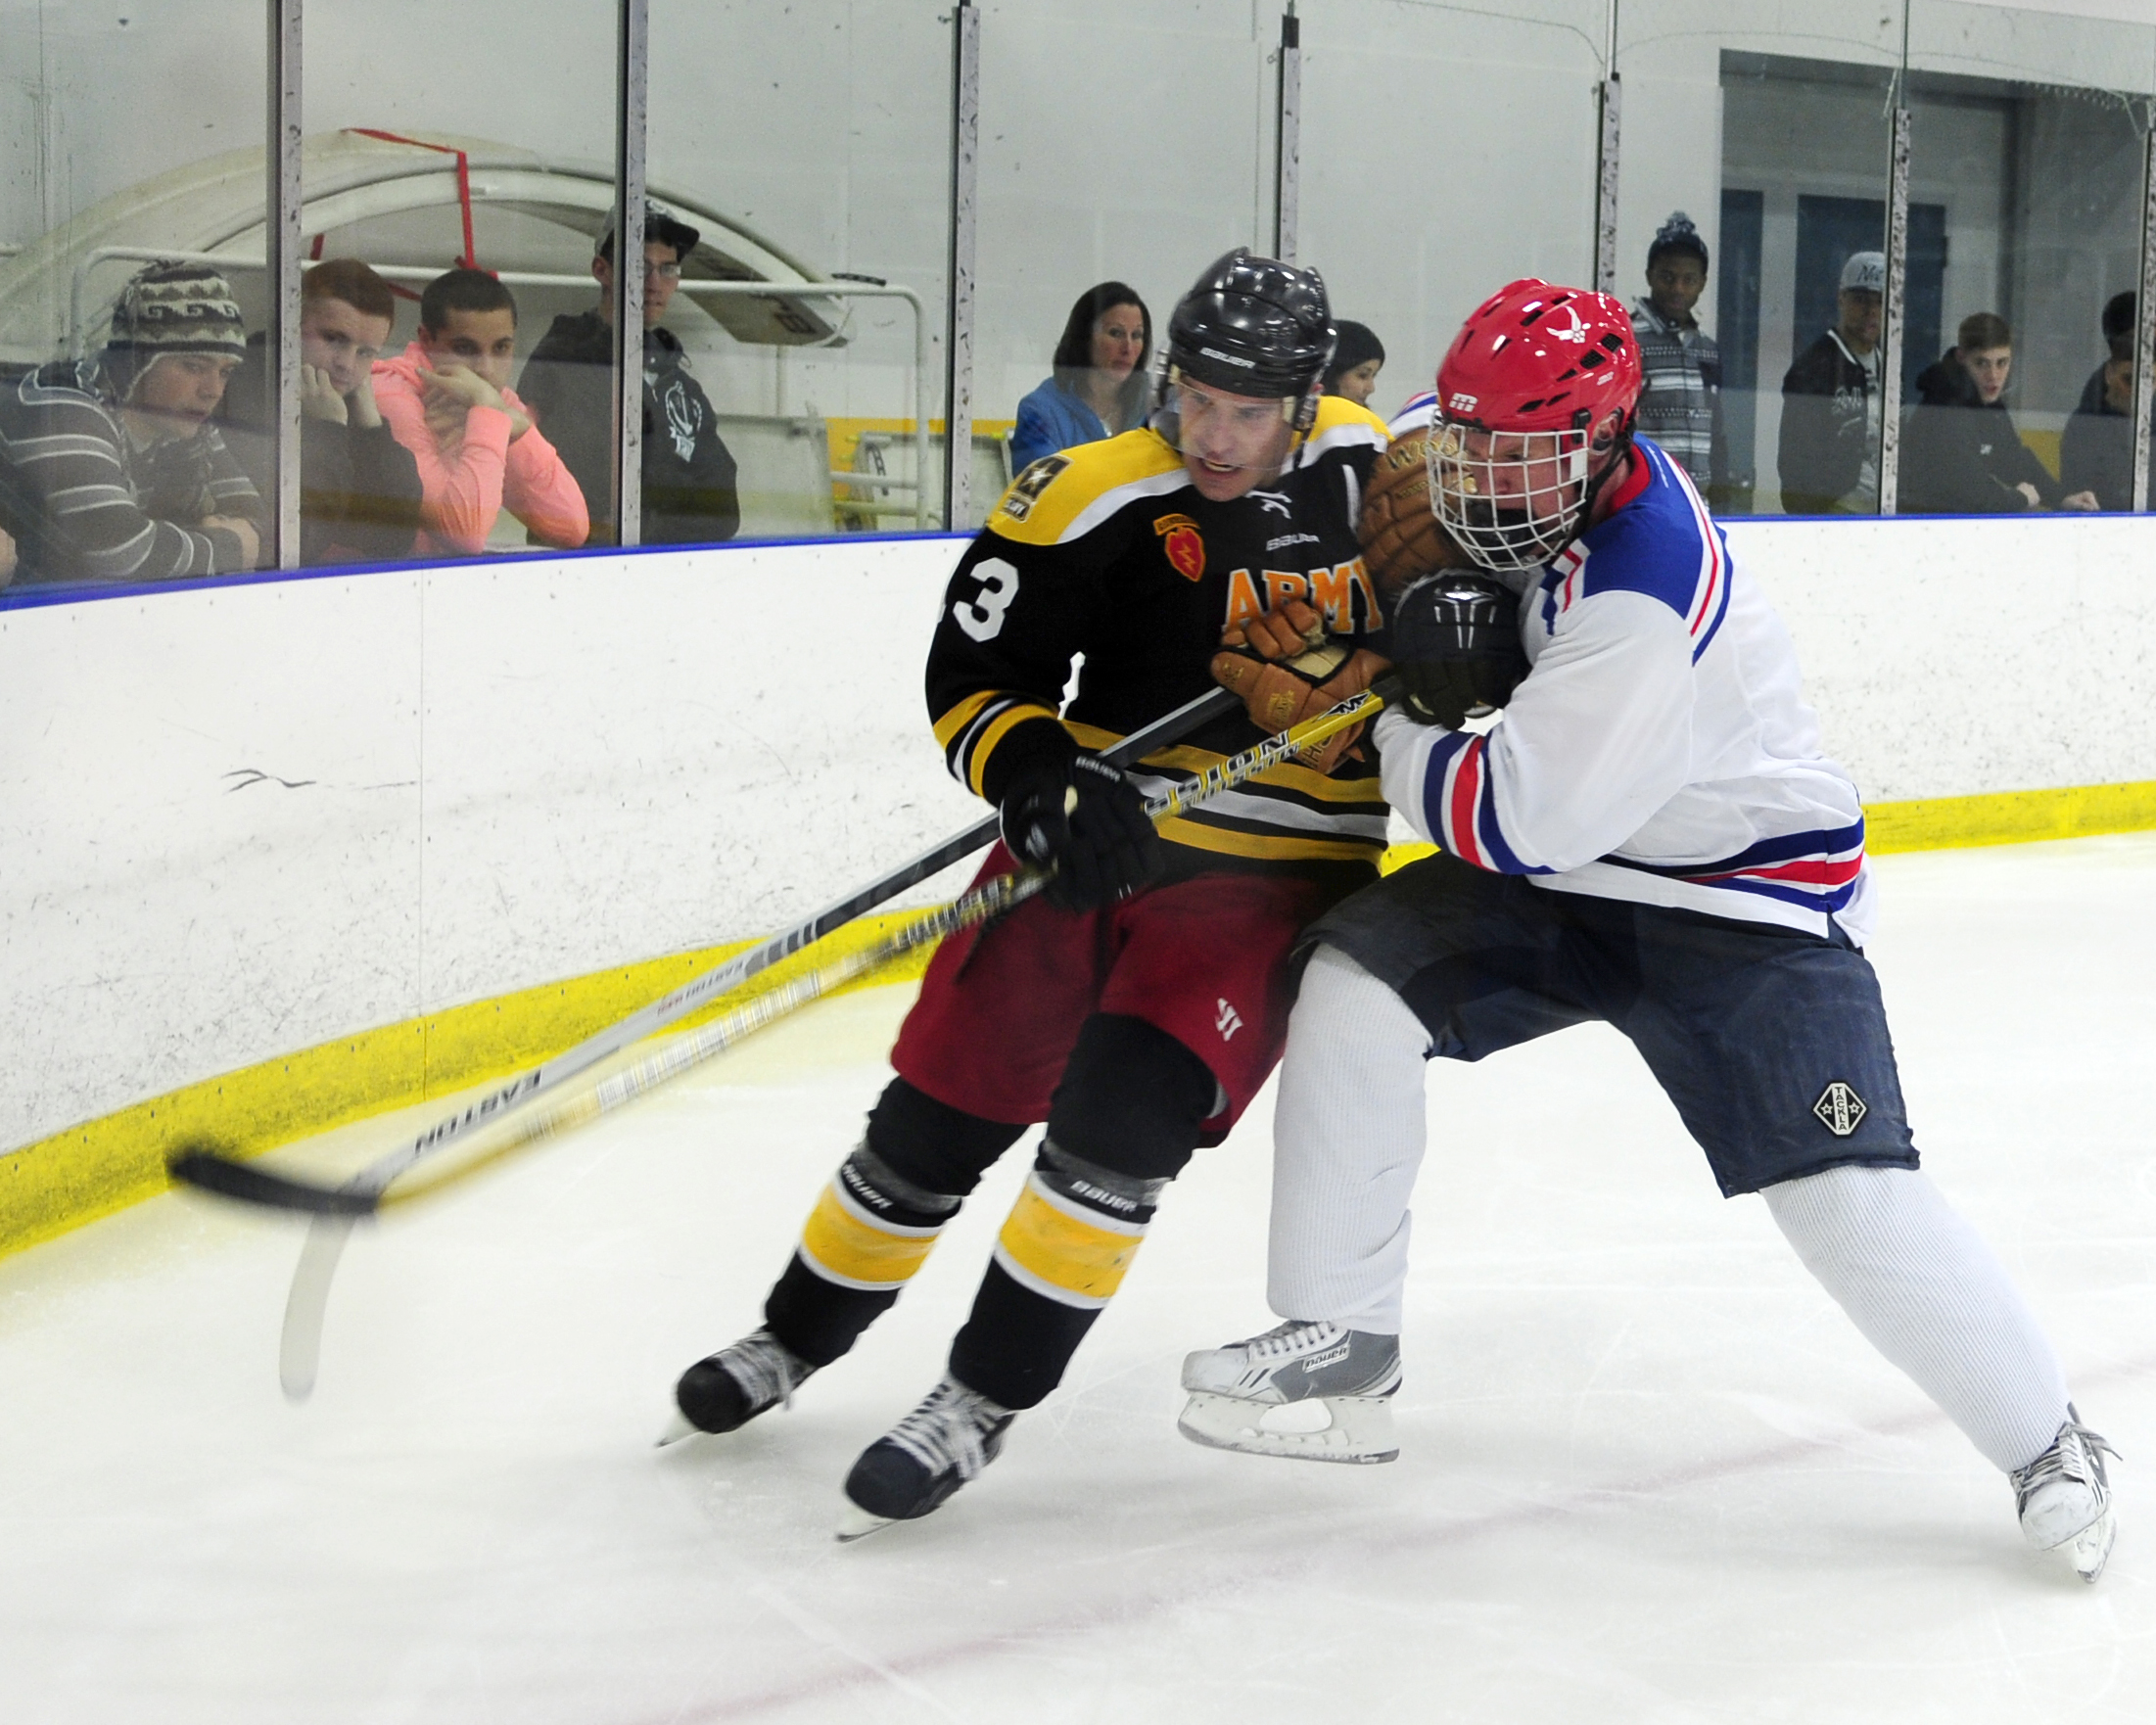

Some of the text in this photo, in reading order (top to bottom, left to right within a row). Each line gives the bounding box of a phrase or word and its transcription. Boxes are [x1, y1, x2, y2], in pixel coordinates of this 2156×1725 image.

[953, 557, 1019, 643] 3
[1221, 554, 1383, 634] ARMY
[1144, 729, 1289, 816] SSION
[414, 1069, 541, 1155] EASTON
[1834, 1087, 1848, 1131] TACKLA
